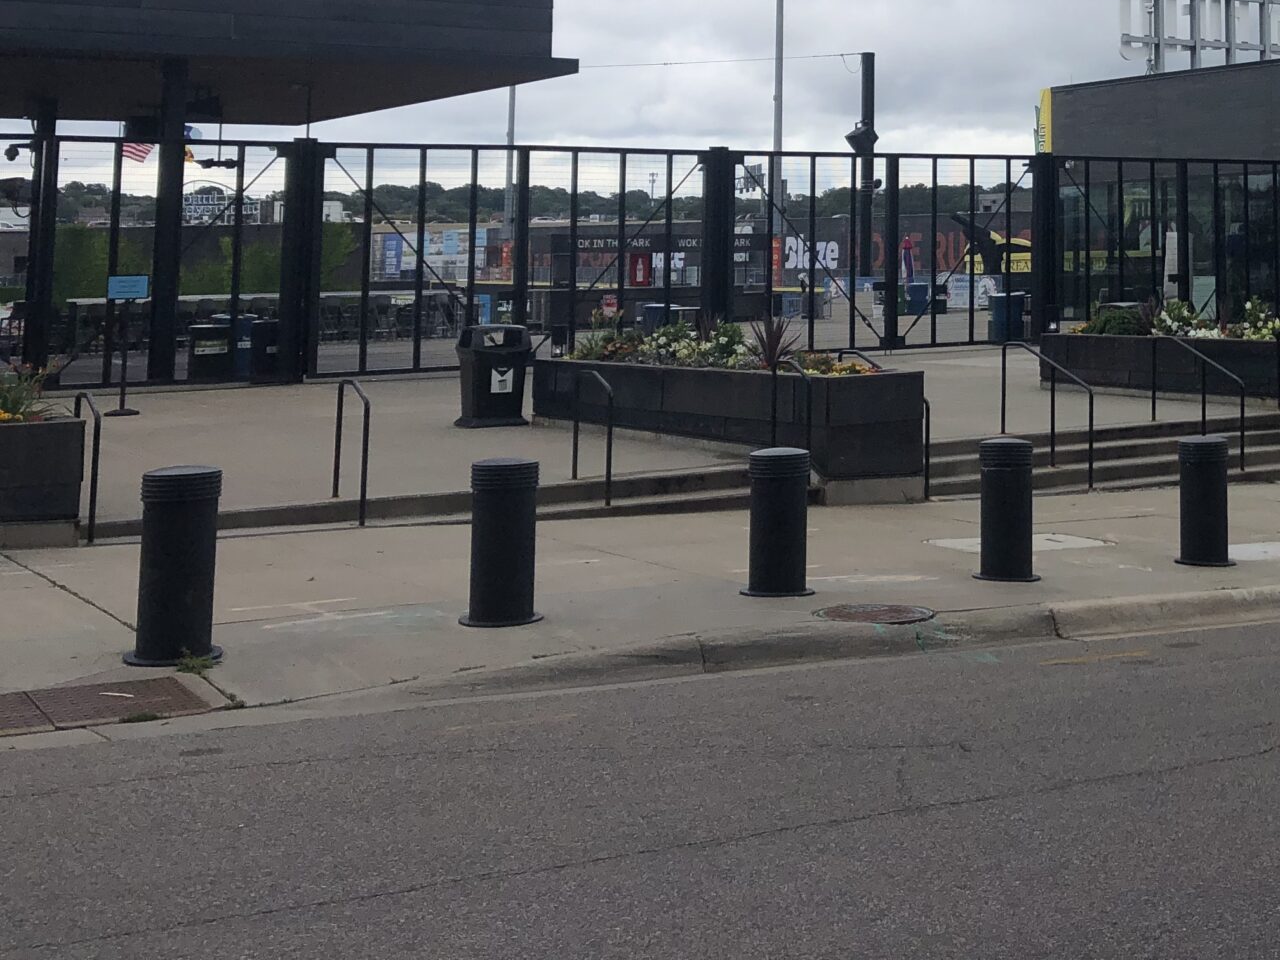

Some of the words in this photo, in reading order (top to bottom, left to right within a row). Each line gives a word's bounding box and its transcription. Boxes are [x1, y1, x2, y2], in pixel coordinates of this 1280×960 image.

[577, 239, 591, 248] OK
[593, 239, 604, 248] IN
[678, 238, 698, 248] WOK
[733, 238, 751, 248] ARK
